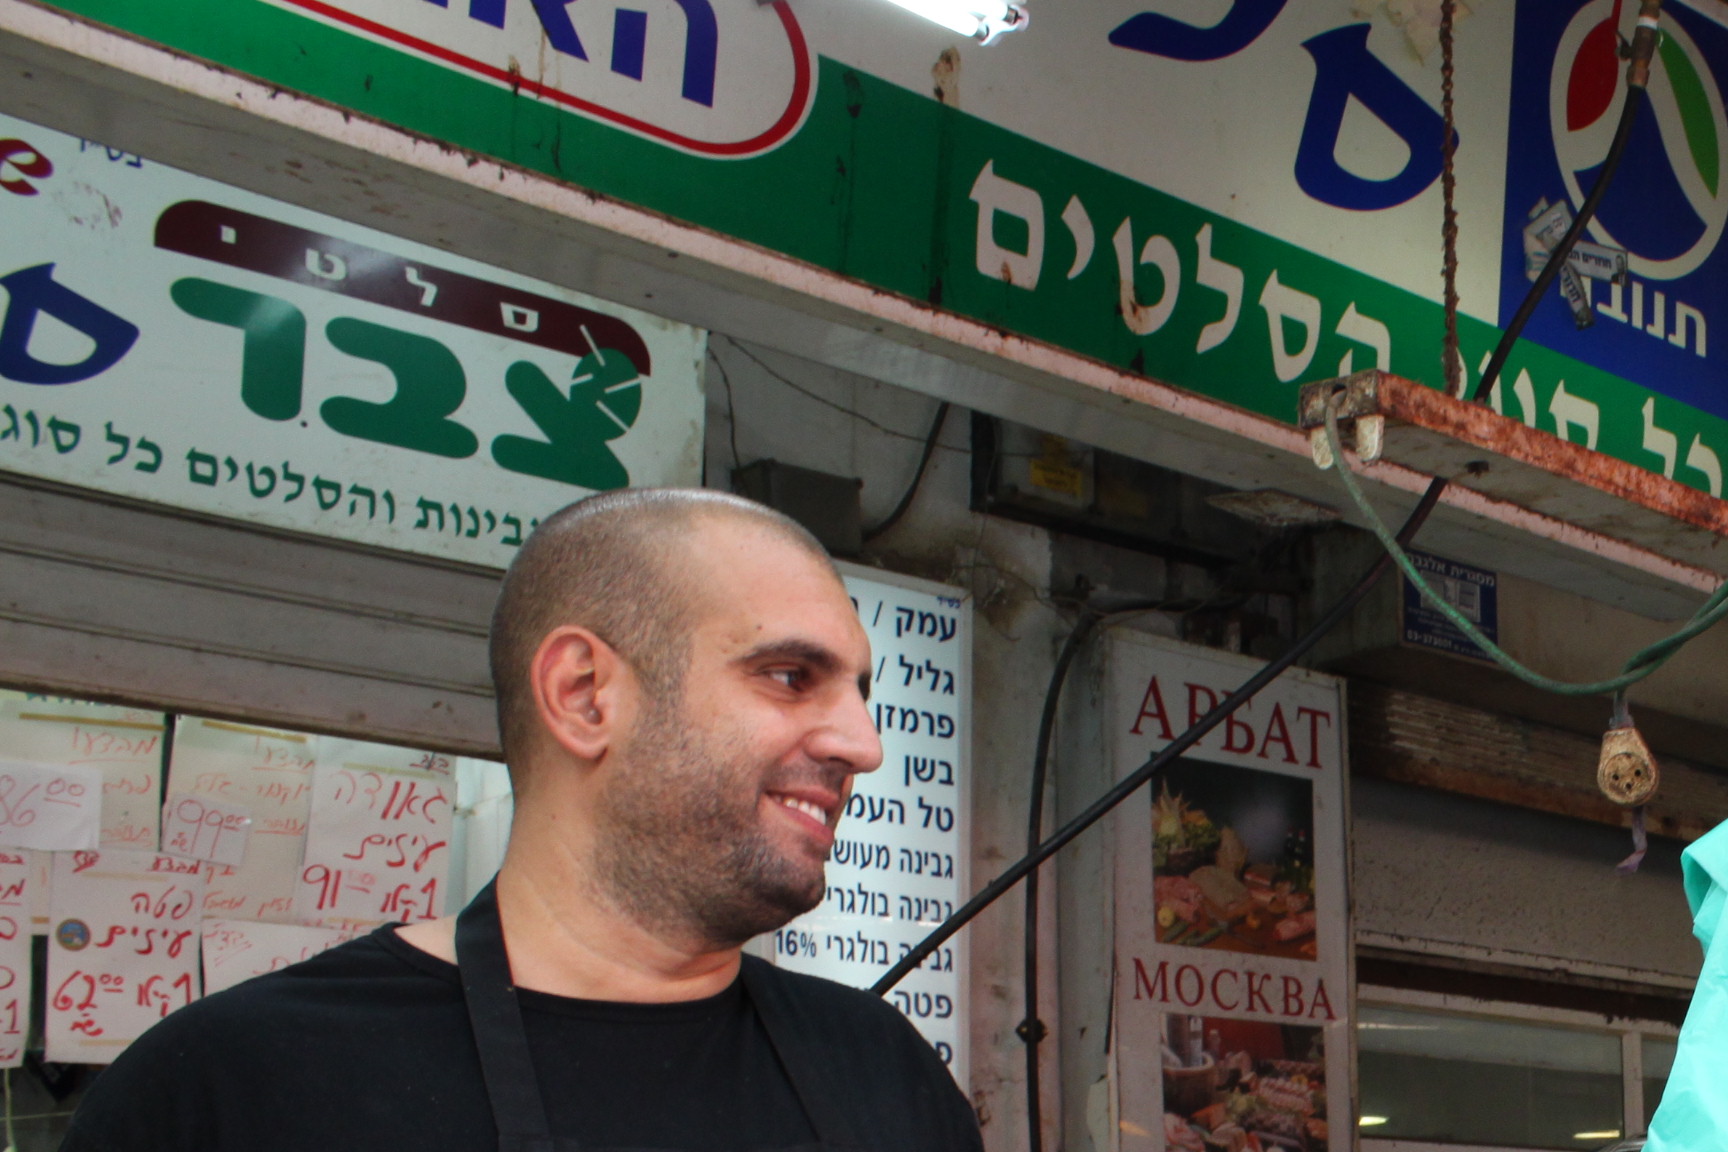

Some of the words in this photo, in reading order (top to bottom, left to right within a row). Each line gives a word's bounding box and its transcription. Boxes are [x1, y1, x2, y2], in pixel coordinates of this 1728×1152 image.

[969, 159, 1391, 384] הסלטים
[170, 276, 642, 491] צבר
[104, 420, 162, 474] כל
[186, 446, 396, 525] והסלטים
[413, 494, 540, 546] בינות
[895, 605, 957, 642] עמק
[898, 653, 955, 696] גליל
[876, 703, 955, 739] פרמזן
[1130, 674, 1331, 768] АРБАТ
[904, 755, 955, 786] בשן
[917, 796, 954, 832] טל
[824, 840, 890, 870] מעוש
[900, 848, 953, 879] גבינה
[827, 883, 889, 918] בולגרי
[776, 929, 817, 958] 16%
[827, 930, 889, 966] בולגרי
[899, 942, 953, 973] גבה
[894, 989, 953, 1019] פטה
[1133, 956, 1337, 1021] МОСКВА
